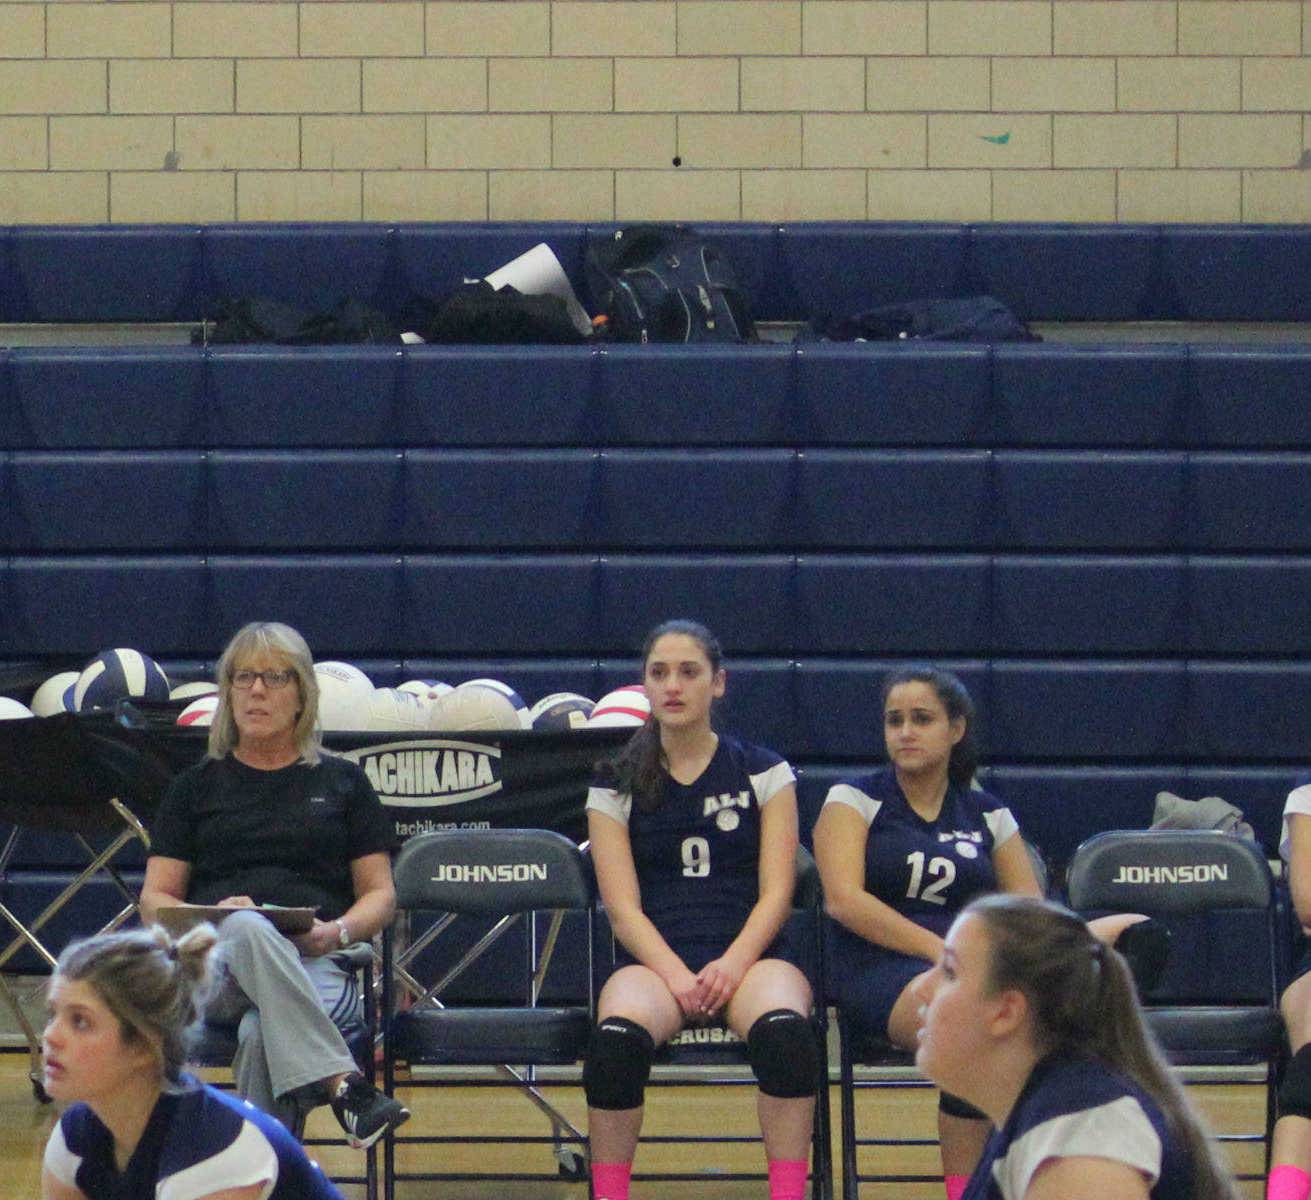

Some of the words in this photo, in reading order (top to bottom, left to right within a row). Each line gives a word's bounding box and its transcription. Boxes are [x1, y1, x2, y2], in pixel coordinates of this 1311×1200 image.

[364, 750, 495, 795] ACHIKARA
[431, 863, 547, 882] JOHNSON
[681, 837, 710, 877] 9
[1112, 864, 1228, 884] JOHNSON
[907, 851, 956, 905] 12
